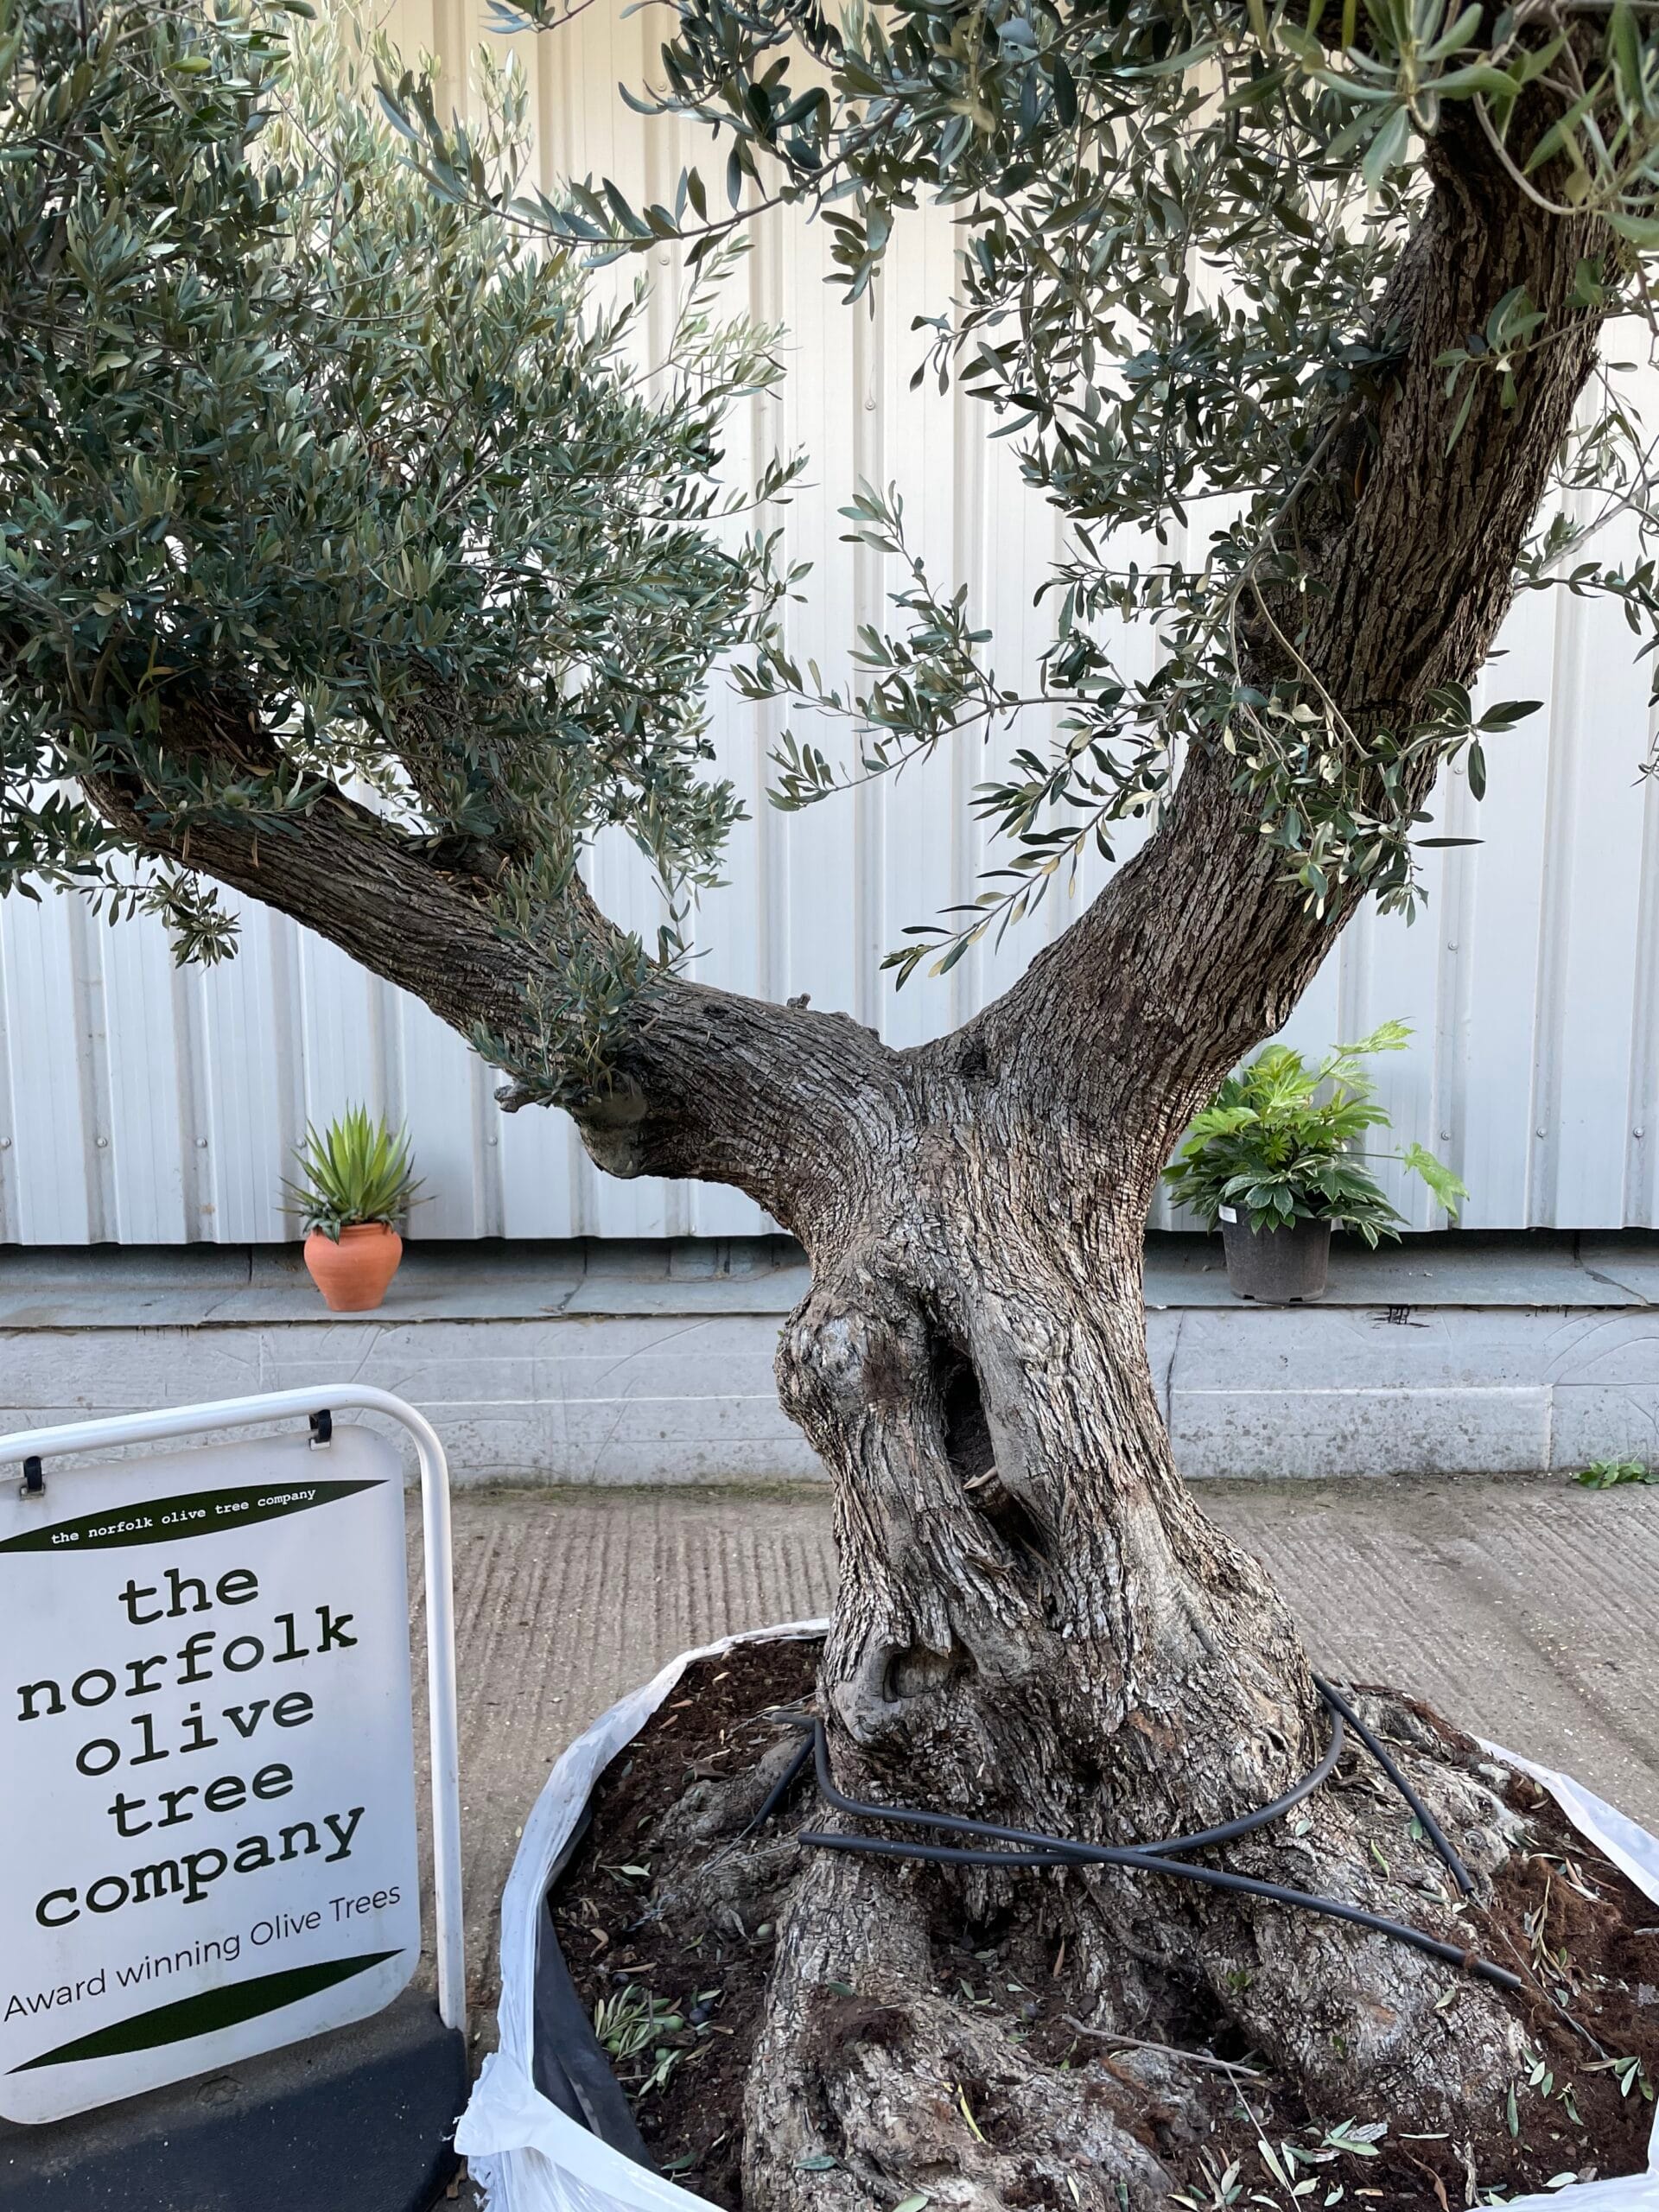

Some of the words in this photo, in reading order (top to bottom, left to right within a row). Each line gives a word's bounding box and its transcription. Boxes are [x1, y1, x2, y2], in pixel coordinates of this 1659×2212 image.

[51, 1529, 79, 1544] the
[88, 1516, 154, 1538] norfolk
[161, 1509, 207, 1524] olive
[214, 1501, 250, 1515] tree
[257, 1489, 316, 1507] company
[118, 1567, 259, 1625] the
[16, 1605, 359, 1722] norfolk
[75, 1691, 314, 1777] olive
[107, 1763, 294, 1838] tree
[35, 1806, 365, 1928] company
[3, 1967, 106, 2023] Award
[116, 1934, 240, 1987] winning
[250, 1910, 321, 1946] Olive
[328, 1885, 401, 1923] Trees
